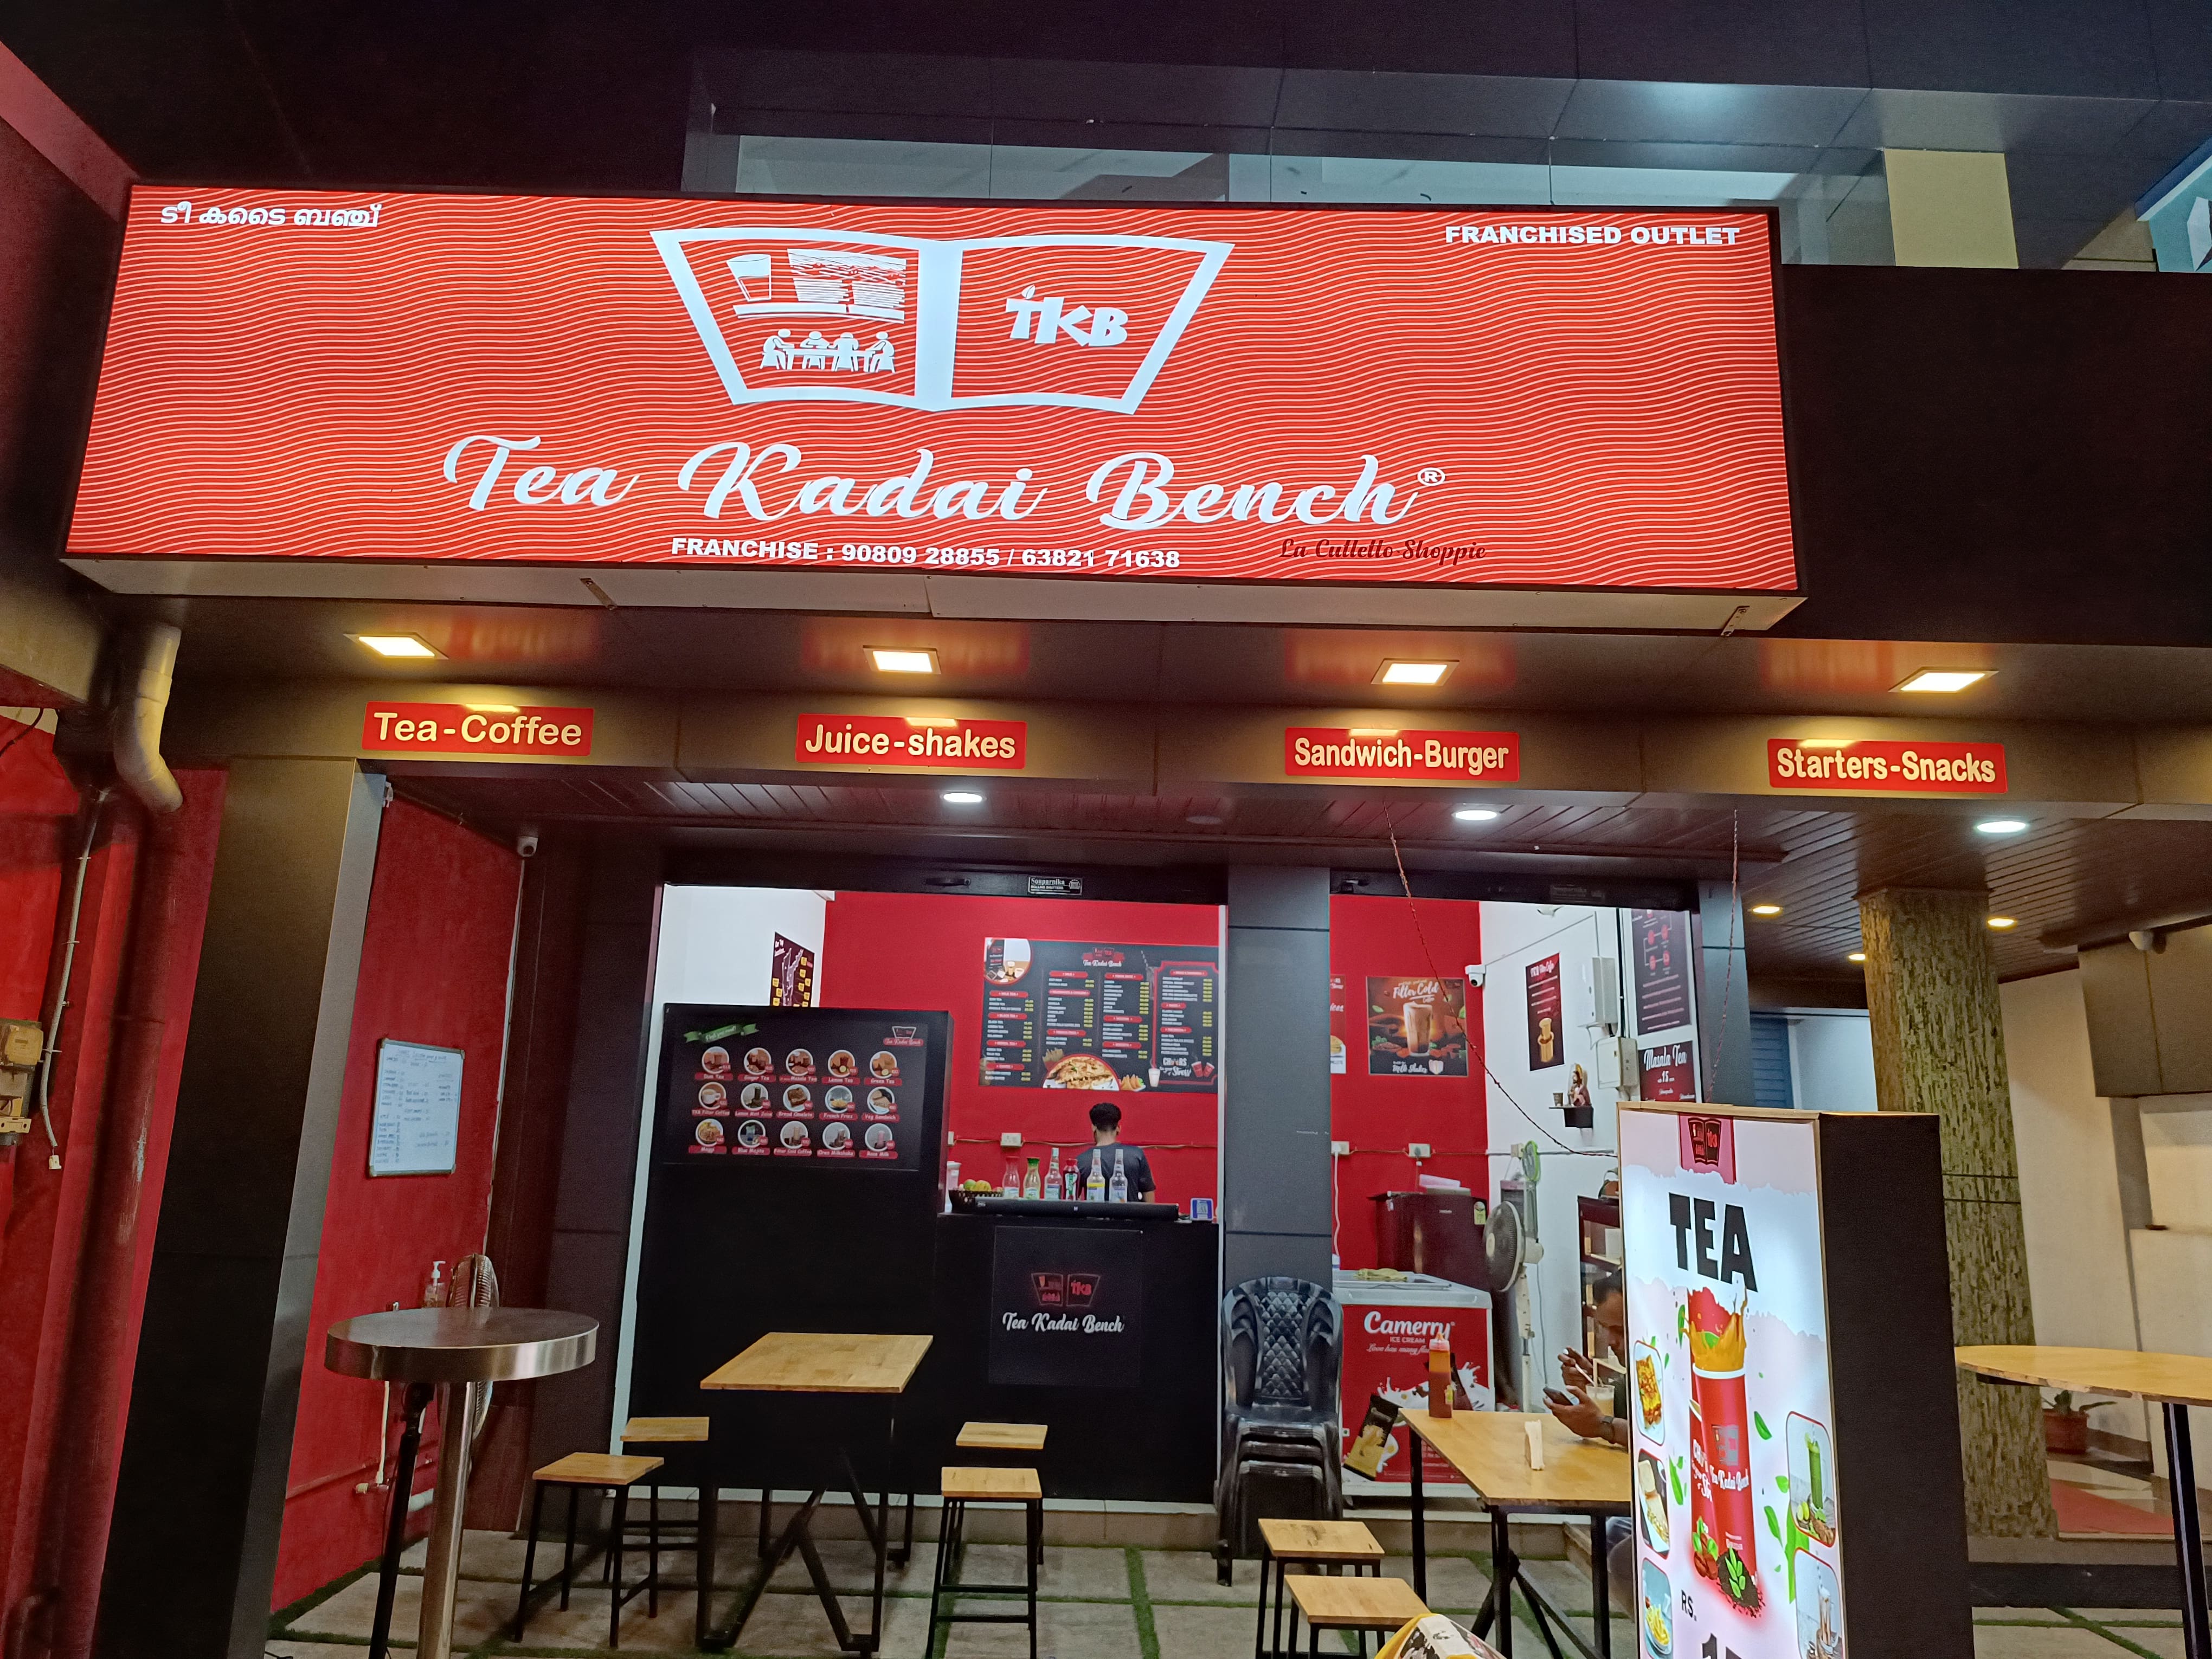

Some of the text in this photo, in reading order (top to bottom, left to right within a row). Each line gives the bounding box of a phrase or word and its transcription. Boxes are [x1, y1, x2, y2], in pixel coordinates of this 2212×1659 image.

[160, 201, 192, 223] ടീ
[1445, 225, 1740, 246] FRANCHISED OUTLET
[443, 434, 639, 511] Tea
[677, 441, 1048, 520] Kadai
[671, 537, 818, 561] FRANCHISE
[841, 544, 916, 564] 90809
[925, 547, 1000, 566] 28855
[1022, 549, 1094, 567] 63821
[1105, 550, 1180, 568] 71638
[1279, 538, 1308, 558] La
[373, 711, 583, 747] Tea-Coffee
[805, 723, 1017, 759] Juice-shakes
[1294, 737, 1509, 774] Sandwich-Burger
[1777, 748, 1996, 783] Starters-Snacks
[1644, 1044, 1687, 1071] Masala Tea
[1668, 1191, 1759, 1293] TEA
[1002, 1312, 1125, 1334] Tea Kadai Bench
[1681, 1590, 1697, 1622] RS.
